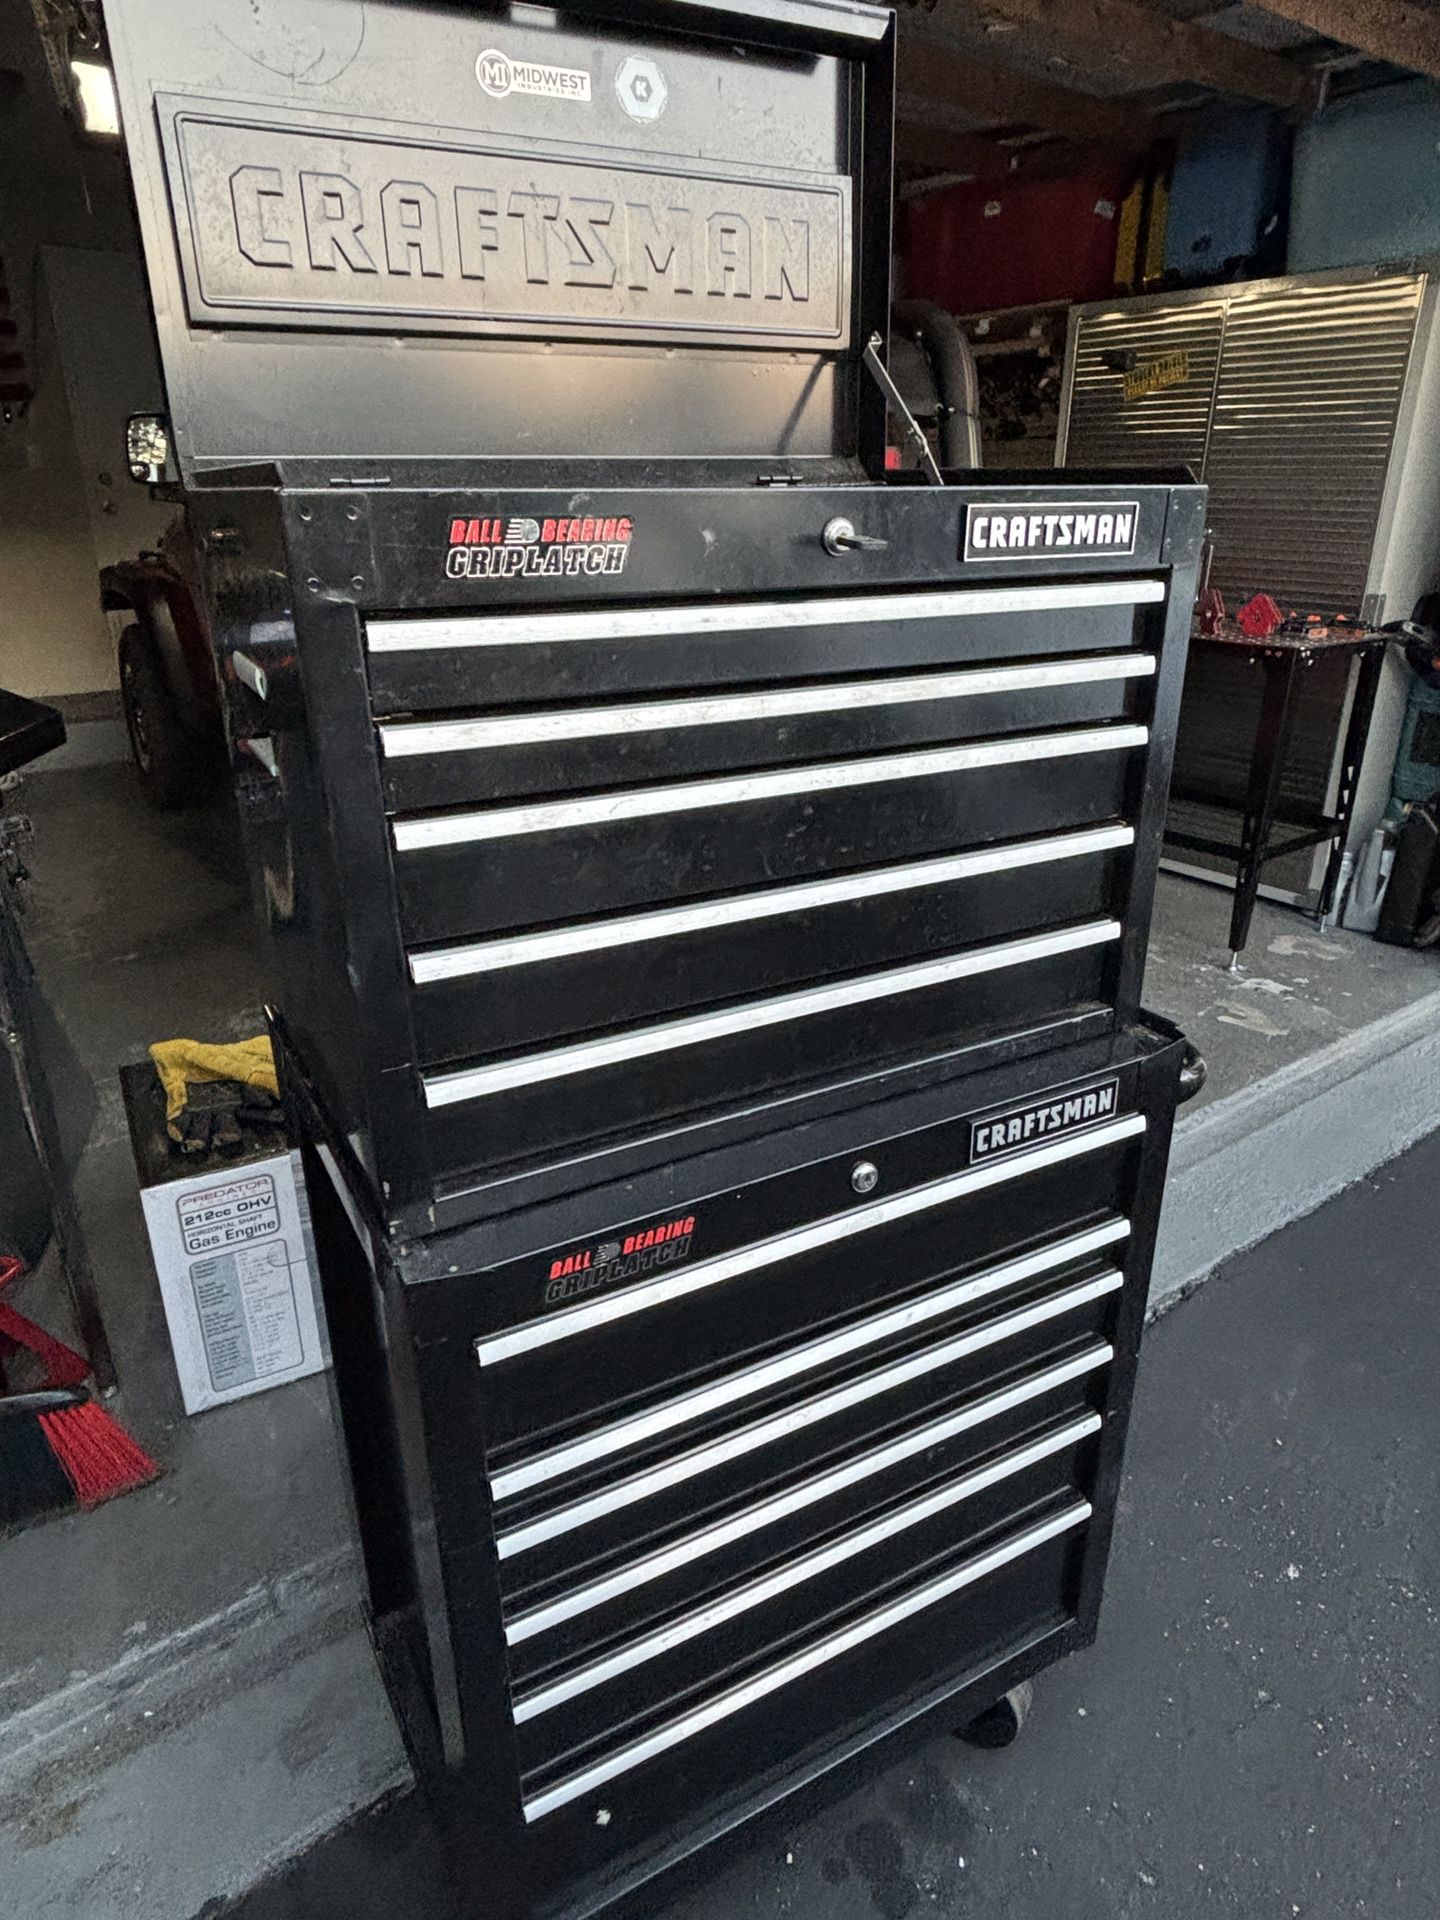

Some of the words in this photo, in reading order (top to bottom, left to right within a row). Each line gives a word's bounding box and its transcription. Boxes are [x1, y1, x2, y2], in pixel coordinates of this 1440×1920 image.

[513, 66, 586, 90] MIDWEST
[634, 80, 647, 98] K
[229, 165, 809, 302] CRAFTSMAN
[450, 519, 502, 543] BALL
[541, 517, 633, 542] BEARING
[972, 514, 1132, 549] CRAFTSMAN
[446, 544, 627, 578] GRIPLATCH
[976, 1088, 1113, 1152] CRAFTSMAN
[182, 1178, 270, 1207] PREDATOR
[184, 1208, 231, 1226] 212cc
[237, 1195, 271, 1212] OHV
[187, 1222, 237, 1238] HORIZONTAL
[239, 1213, 263, 1225] SHAFT
[189, 1235, 220, 1250] Gas
[225, 1220, 276, 1240] Engine
[549, 1250, 592, 1280] BALL
[622, 1216, 695, 1255] BEARING
[545, 1235, 692, 1303] GRIPLATCH
